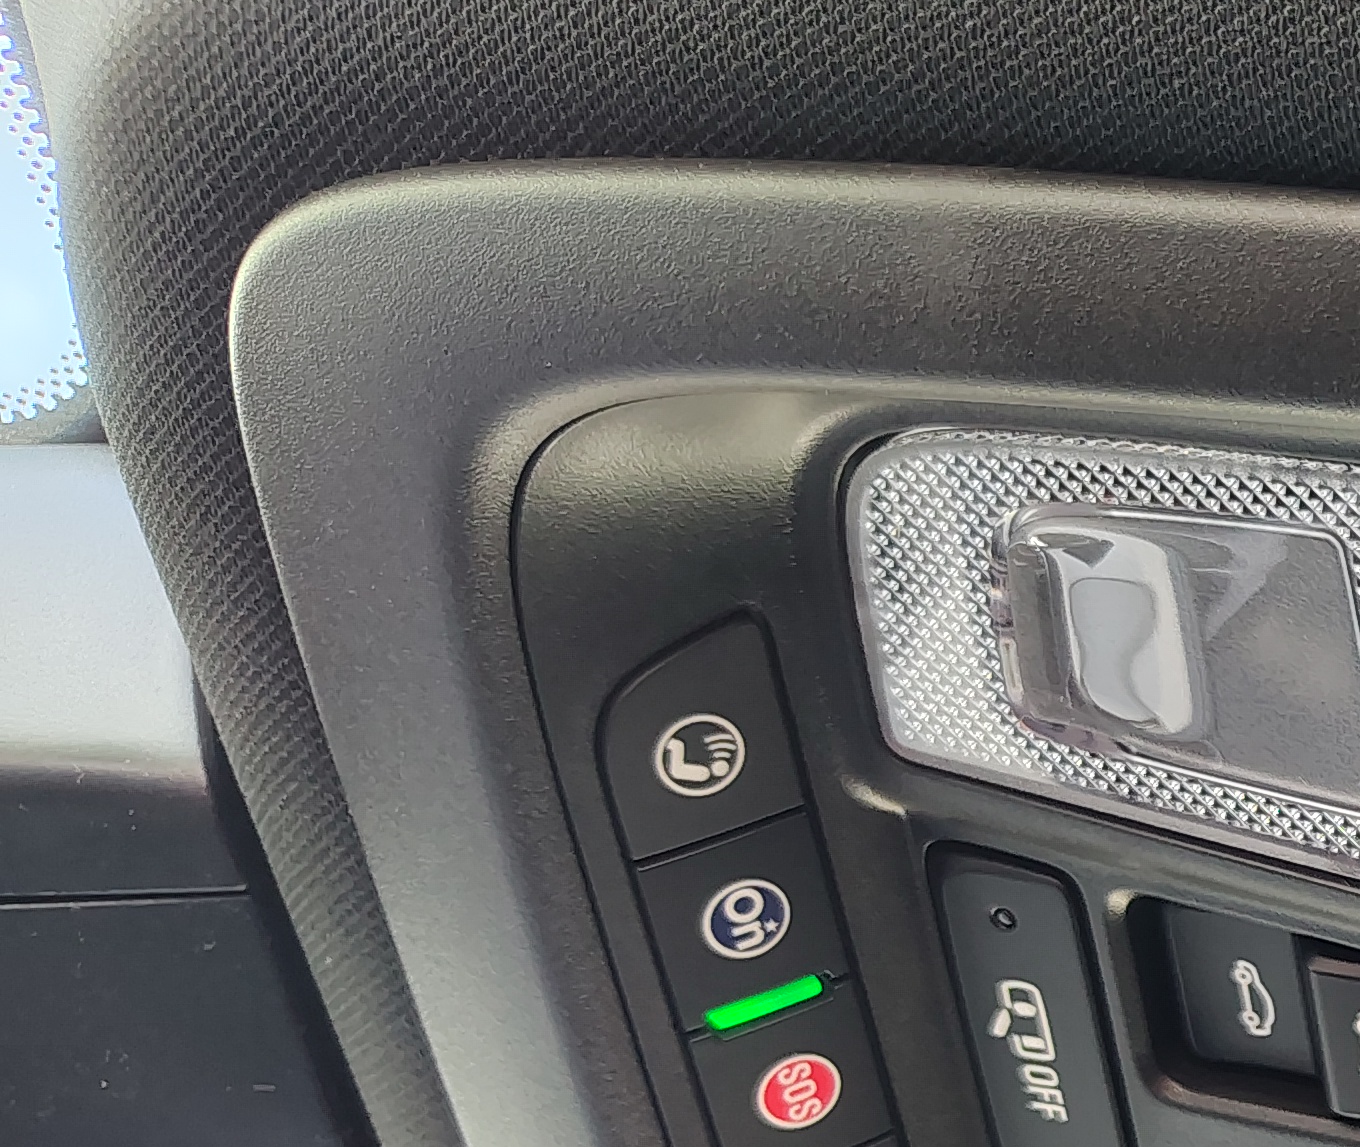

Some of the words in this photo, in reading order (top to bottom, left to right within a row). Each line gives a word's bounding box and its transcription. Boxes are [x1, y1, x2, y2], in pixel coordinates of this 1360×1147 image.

[721, 885, 770, 951] On
[777, 1061, 823, 1122] SOS
[1019, 1063, 1068, 1124] OFF
